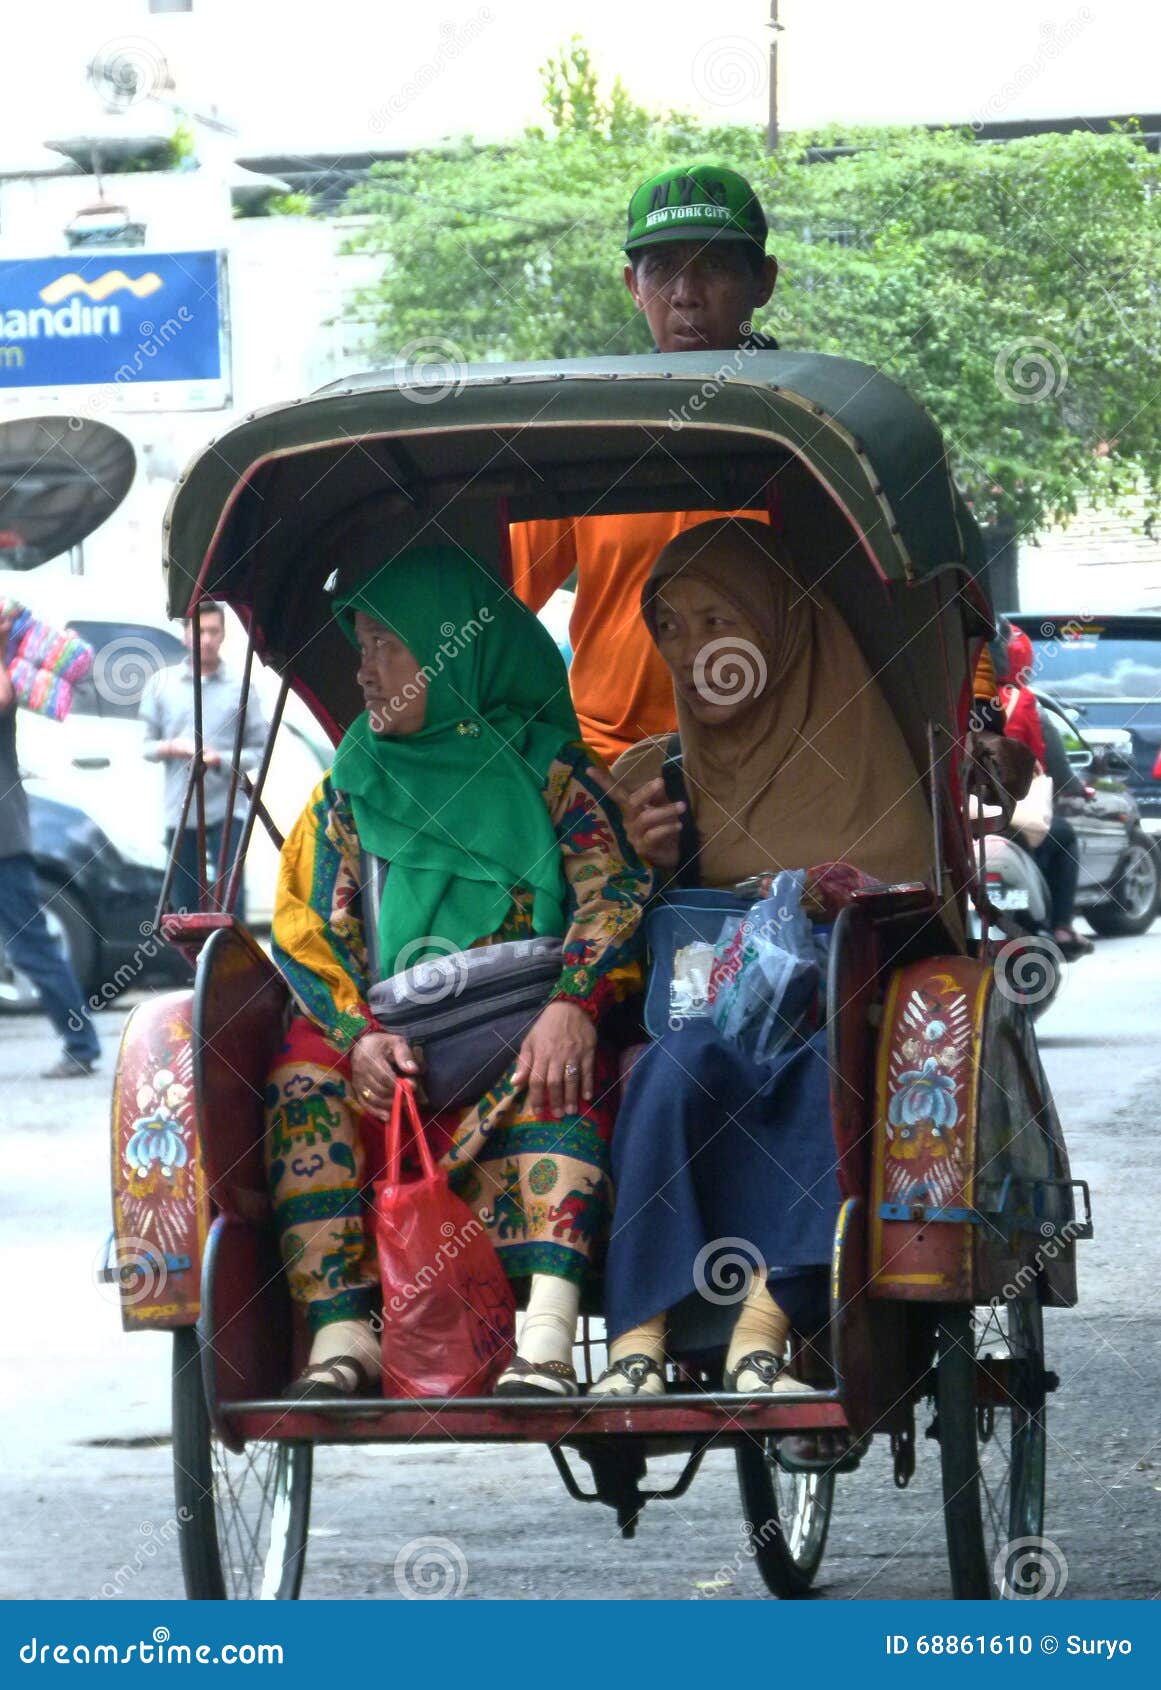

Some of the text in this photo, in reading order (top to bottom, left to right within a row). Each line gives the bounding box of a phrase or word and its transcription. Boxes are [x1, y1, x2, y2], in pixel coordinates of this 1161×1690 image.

[646, 207, 732, 228] NEW YORK CITY
[0, 297, 120, 338] andiri
